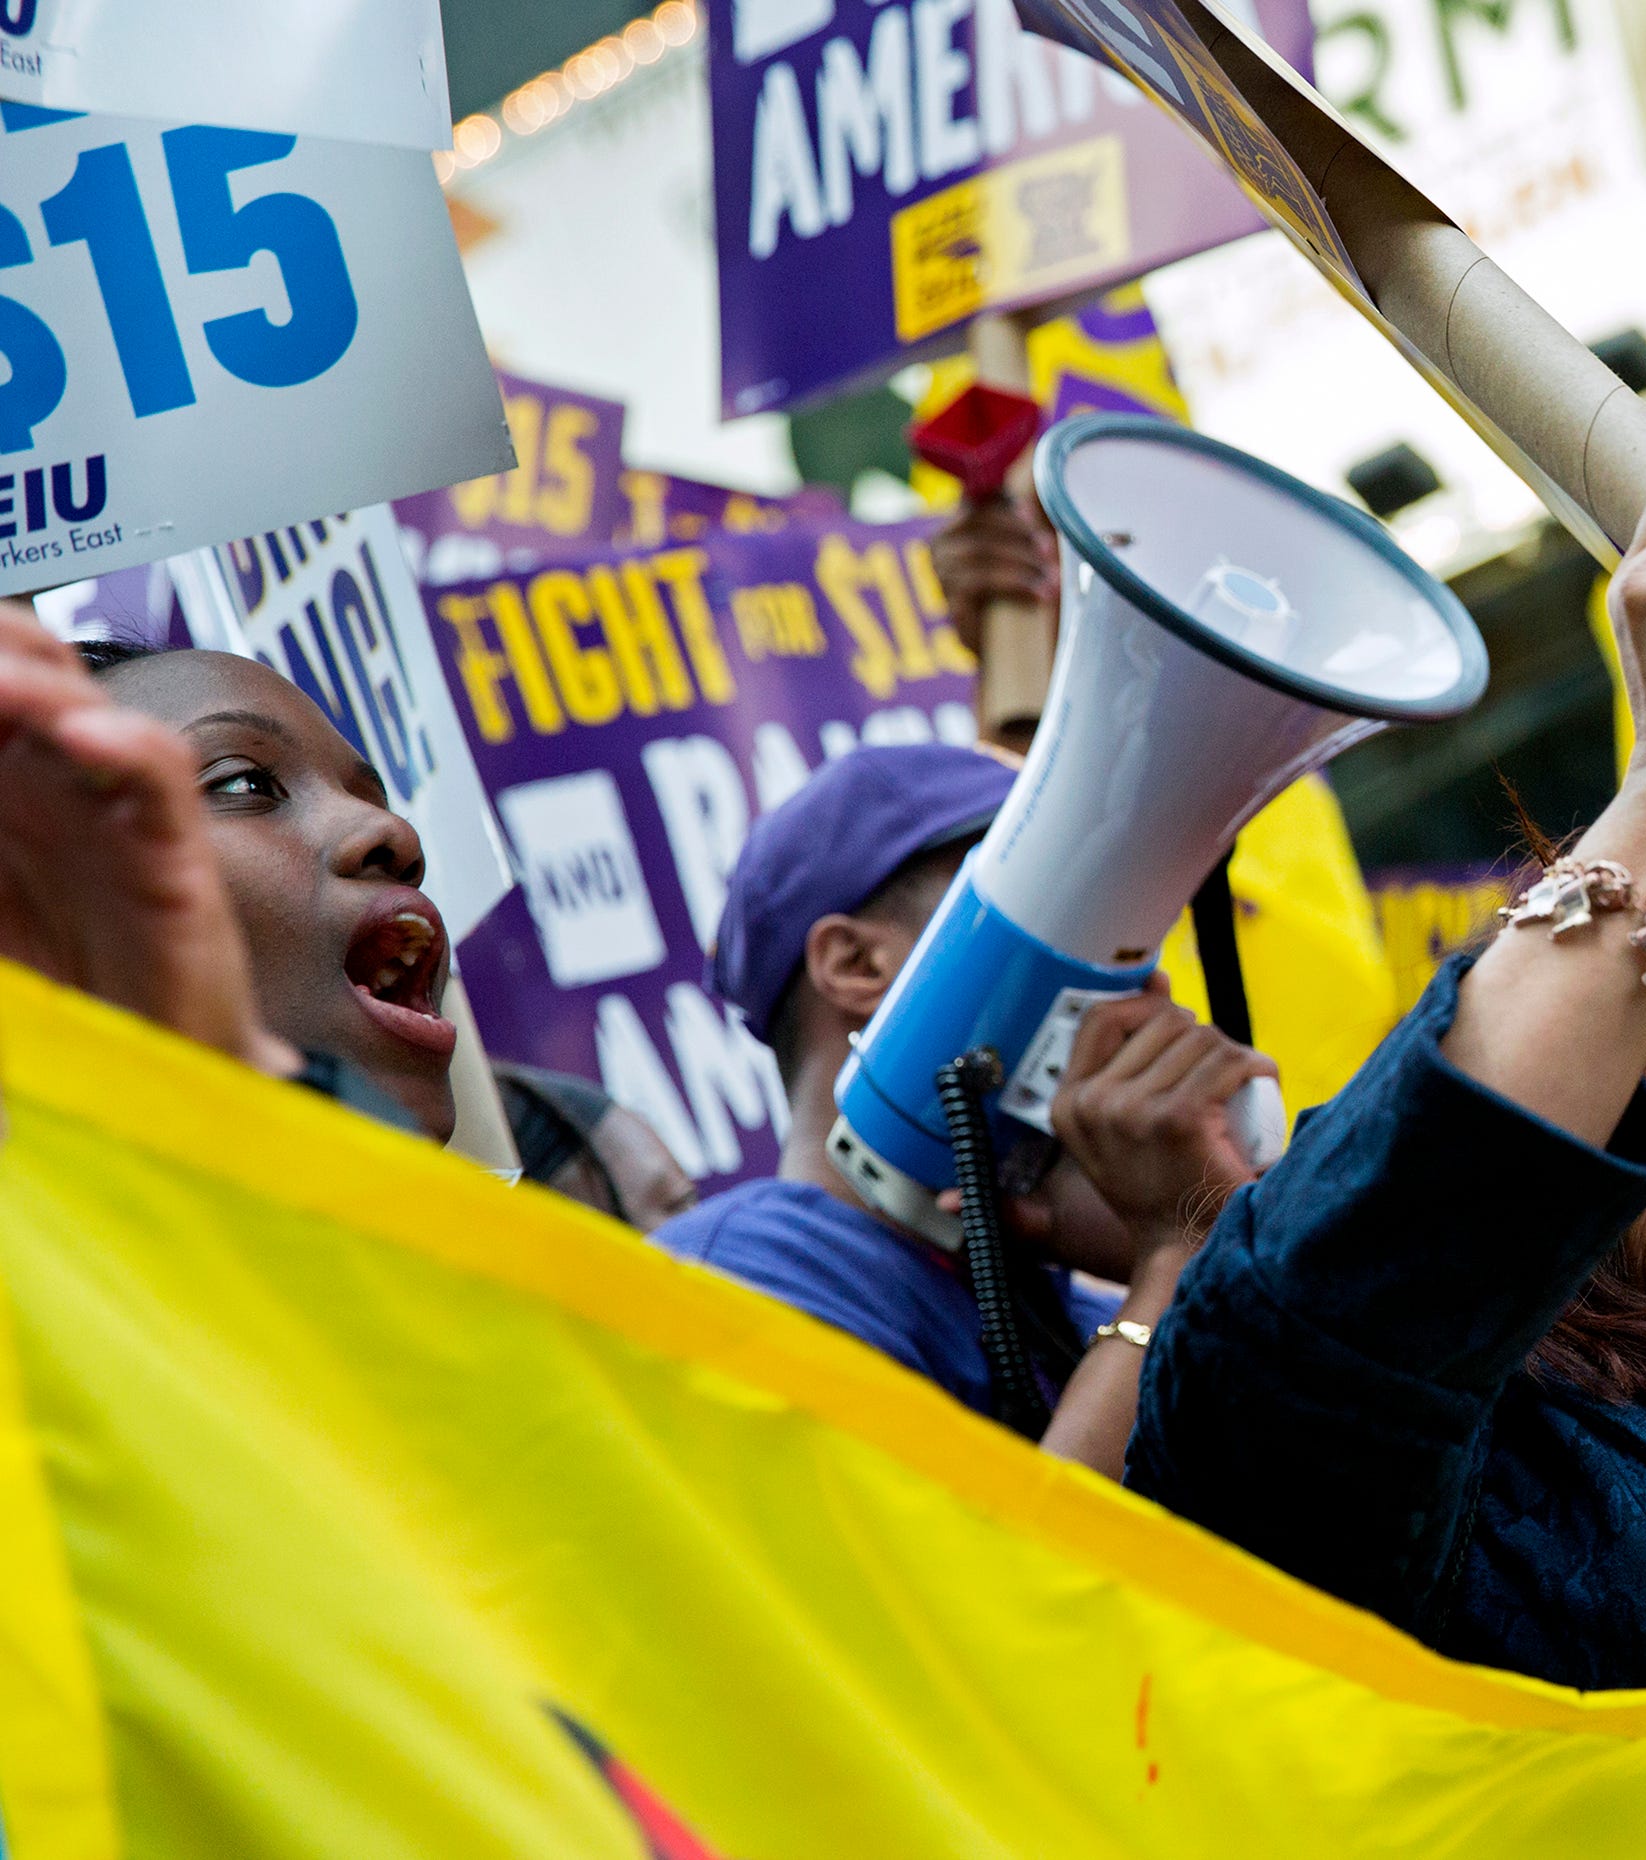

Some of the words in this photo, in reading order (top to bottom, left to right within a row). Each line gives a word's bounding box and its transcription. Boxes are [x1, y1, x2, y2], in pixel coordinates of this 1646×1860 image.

[748, 0, 1146, 260] AMER
[68, 522, 123, 553] East
[438, 545, 736, 745] FIGHT
